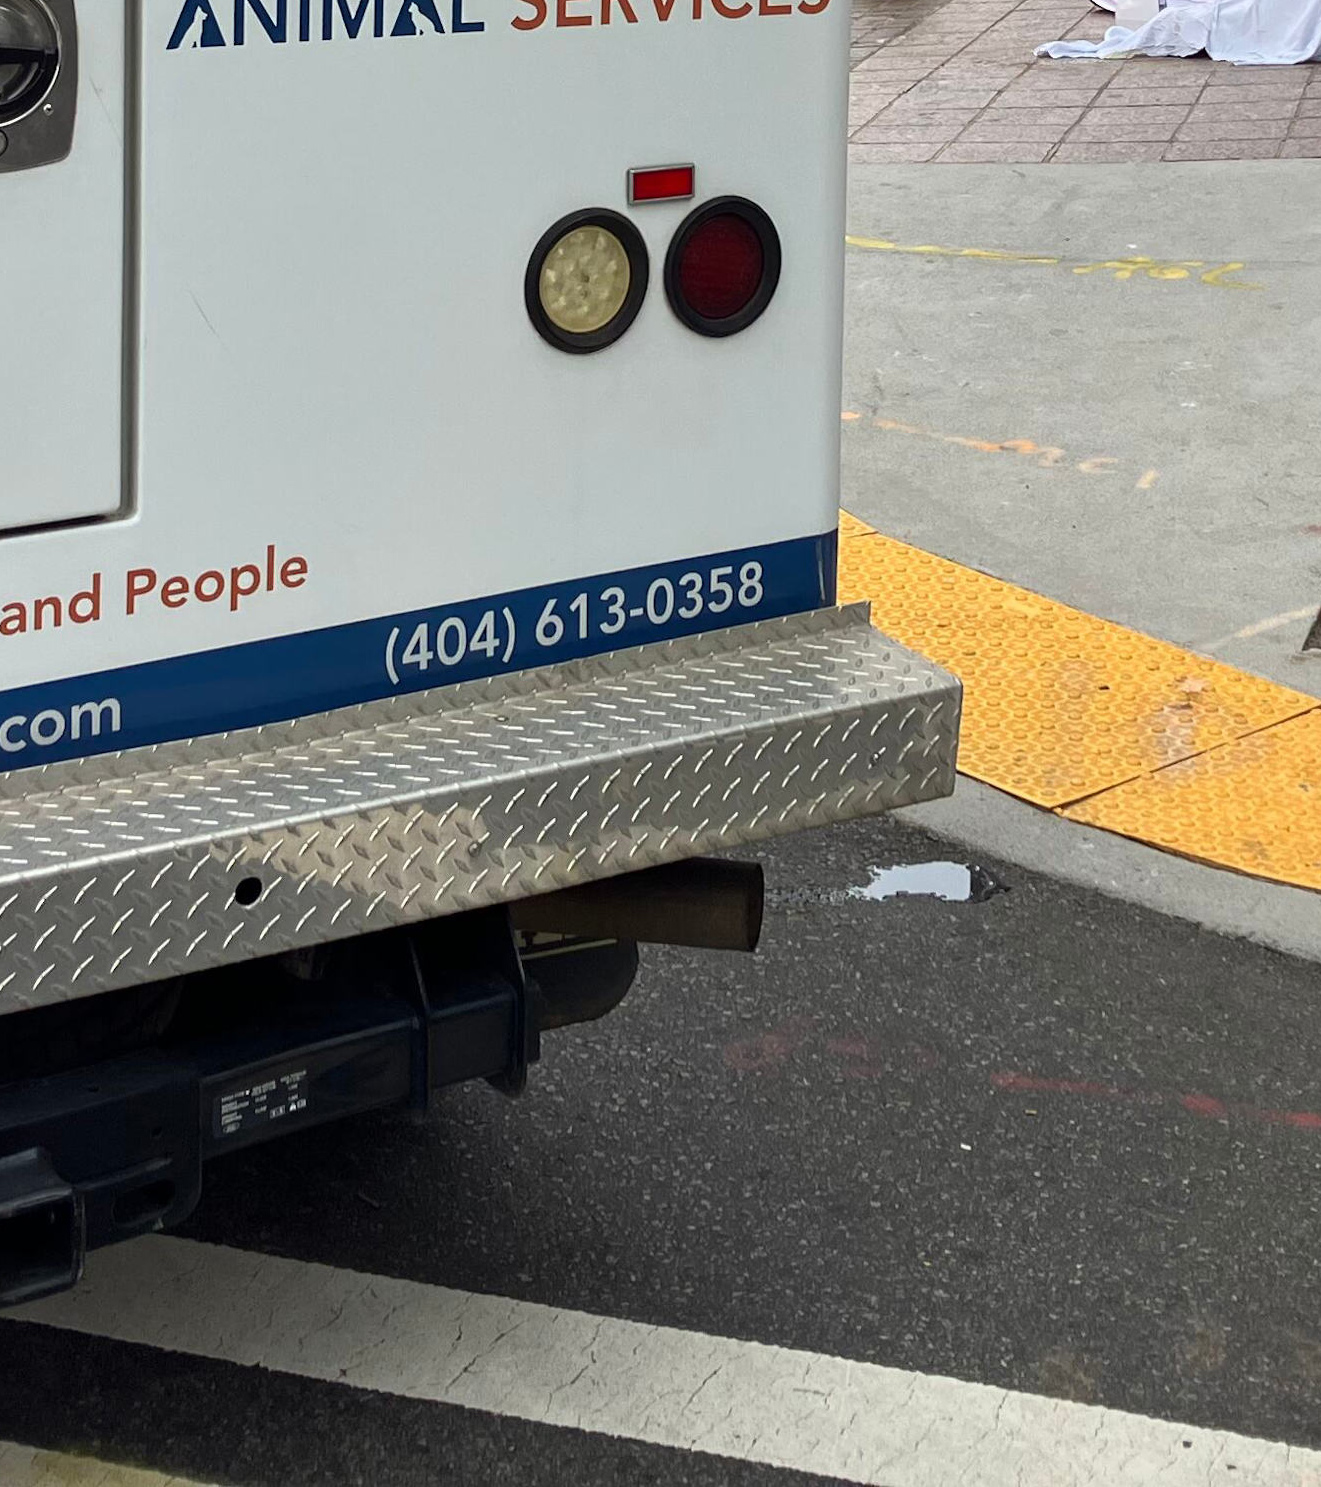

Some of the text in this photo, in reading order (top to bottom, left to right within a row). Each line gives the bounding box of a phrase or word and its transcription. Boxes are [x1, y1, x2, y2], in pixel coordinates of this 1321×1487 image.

[125, 544, 310, 615] People
[384, 560, 765, 685] (404) 613-0358
